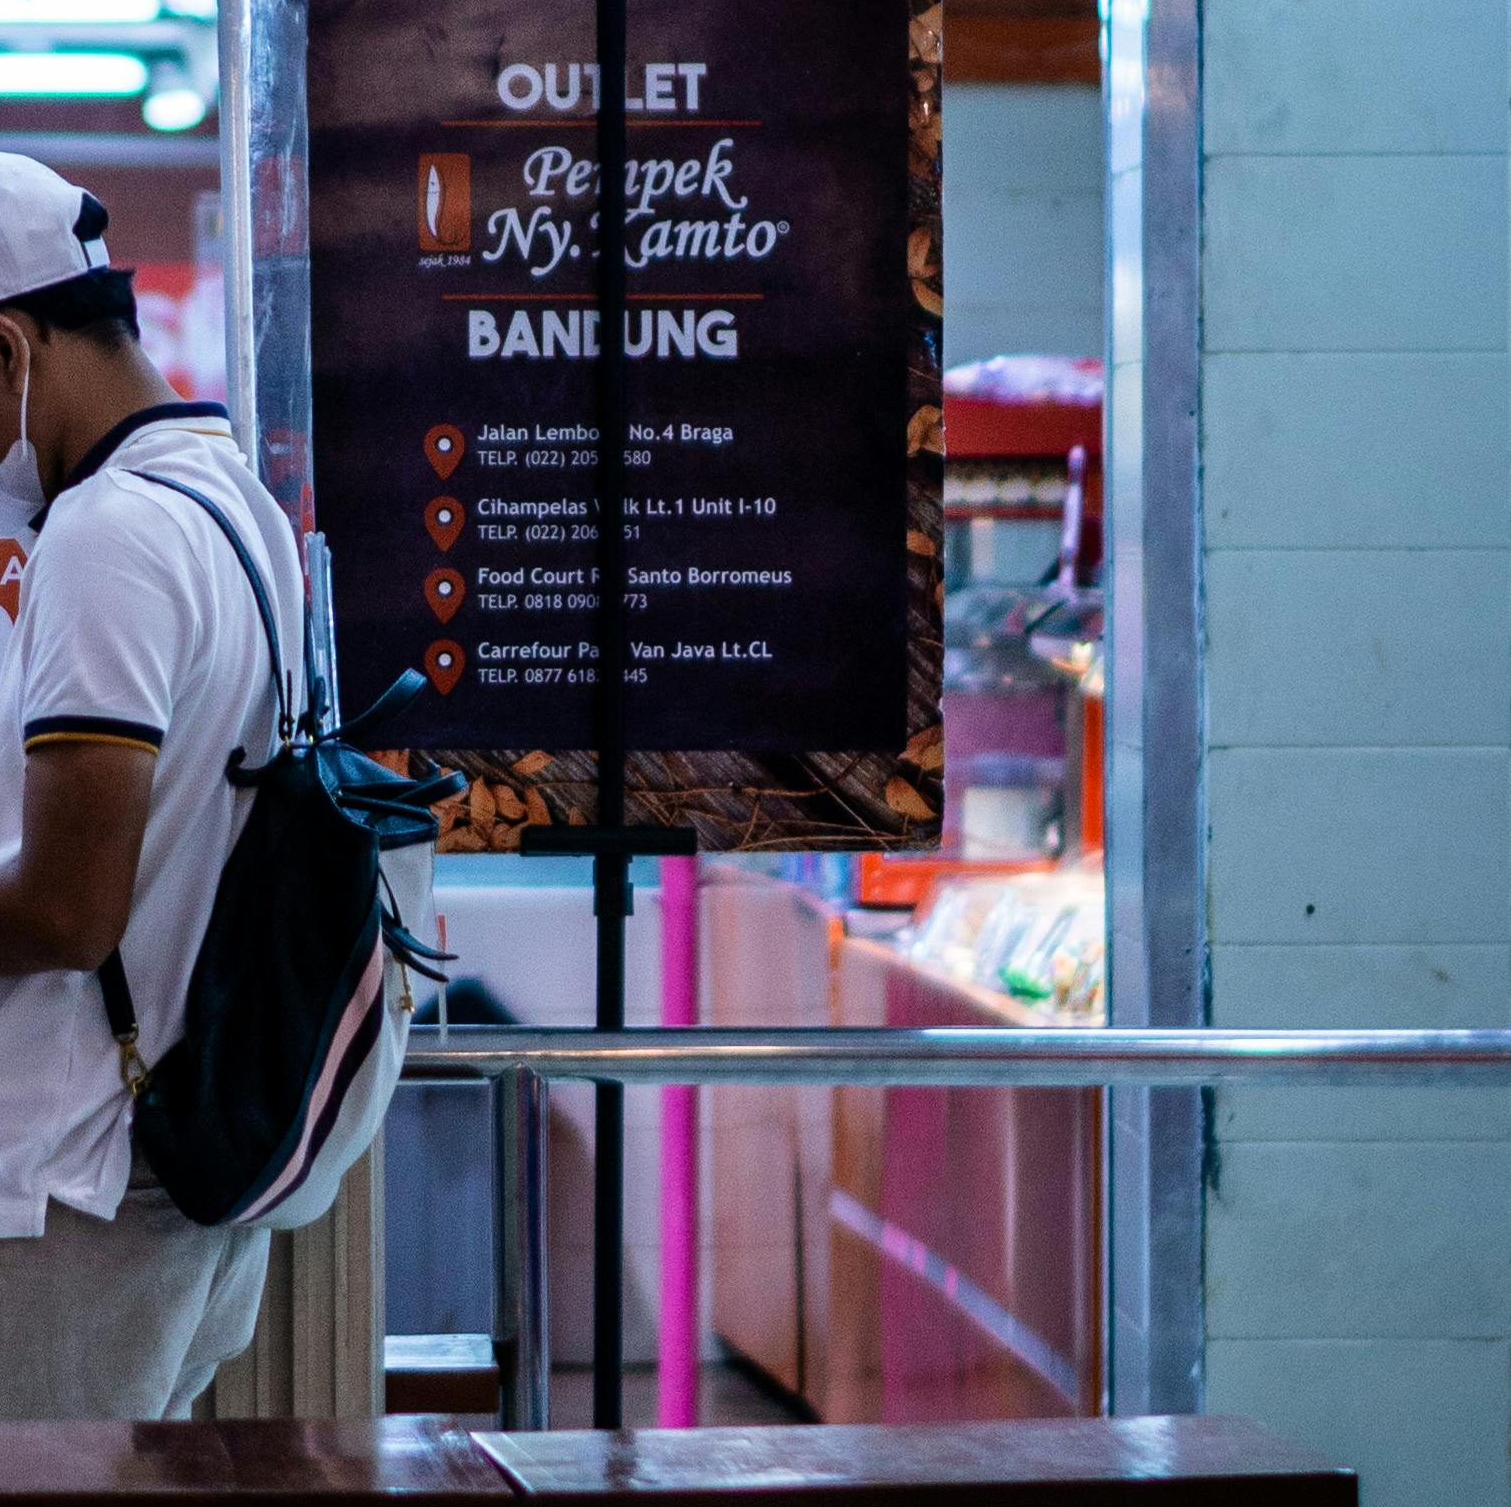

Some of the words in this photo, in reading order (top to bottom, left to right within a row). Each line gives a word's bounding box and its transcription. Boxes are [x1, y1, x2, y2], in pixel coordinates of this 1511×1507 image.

[482, 205, 580, 276] Ny.
[590, 211, 777, 268] amto
[477, 423, 529, 442] Jalan
[535, 423, 600, 442] Lembo
[629, 423, 675, 442] No.4
[680, 423, 734, 445] Braga
[477, 450, 518, 467] TELP.
[525, 449, 566, 469] (022)
[571, 450, 599, 467] 205
[623, 450, 652, 467] 580
[477, 497, 588, 520] Cihampelas
[646, 498, 683, 516] Lt.1
[692, 498, 733, 516] Unit
[477, 524, 518, 541] TELP.
[525, 523, 566, 543] (022)
[571, 524, 599, 541] 206
[477, 567, 525, 585] Food
[530, 567, 585, 585] Court
[627, 566, 682, 585] Santo
[687, 567, 793, 585] Borromeus
[477, 593, 518, 609] TELP.
[524, 593, 563, 609] 0818
[567, 593, 600, 609] 090
[477, 640, 573, 659] Carrefour
[630, 641, 665, 659] Van
[670, 641, 716, 659] Java
[721, 640, 773, 659] Lt.CL
[477, 667, 518, 683] TELP.
[524, 667, 563, 683] 0877
[567, 667, 600, 683] 618
